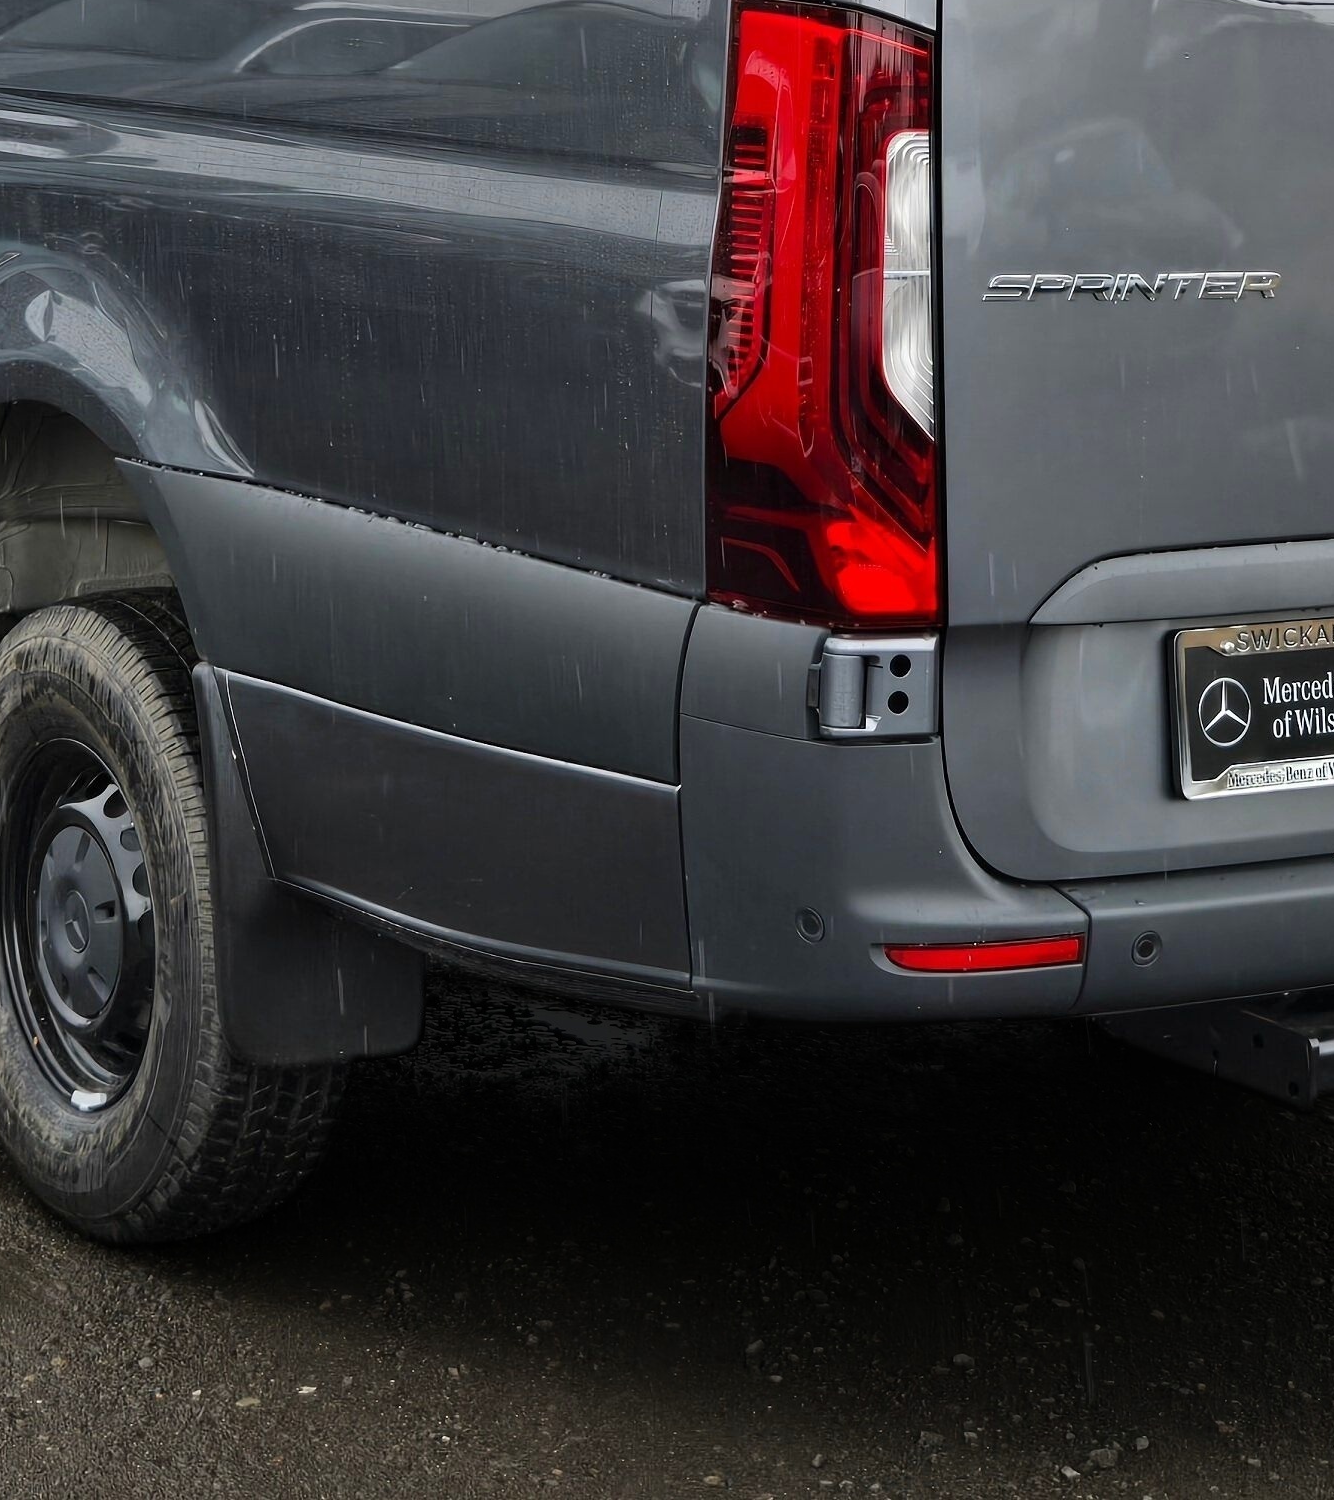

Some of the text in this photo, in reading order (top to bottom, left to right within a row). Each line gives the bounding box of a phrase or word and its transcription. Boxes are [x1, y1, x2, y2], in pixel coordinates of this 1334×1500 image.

[982, 270, 1282, 302] SPRINTER
[1272, 711, 1292, 738] of
[1316, 763, 1327, 779] of
